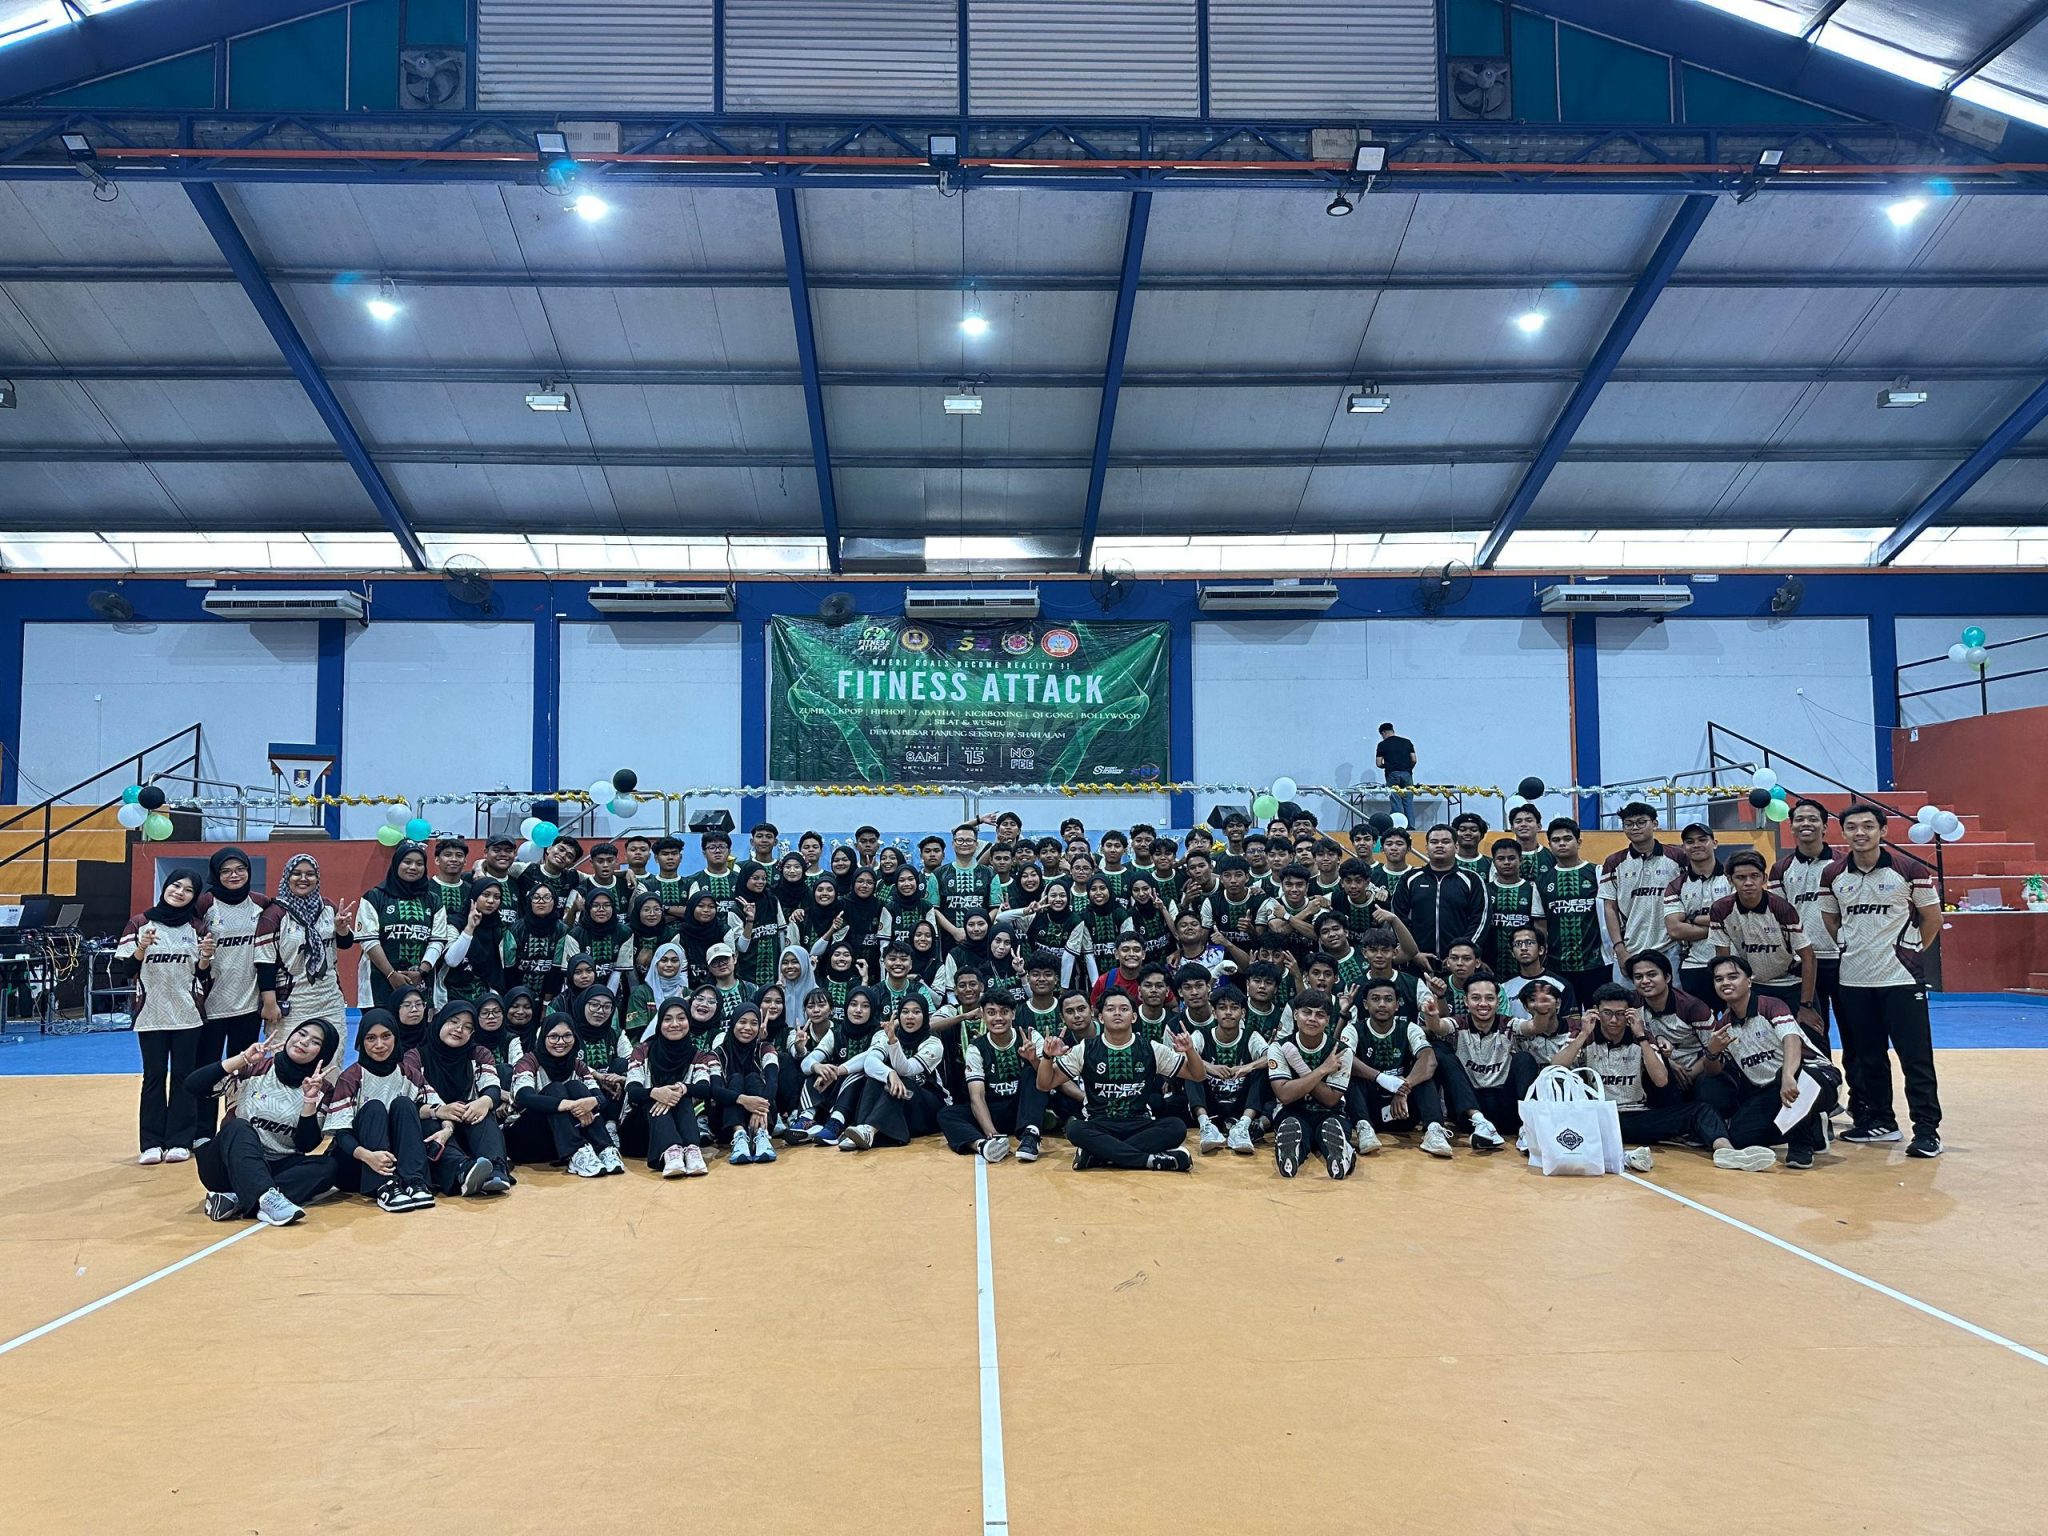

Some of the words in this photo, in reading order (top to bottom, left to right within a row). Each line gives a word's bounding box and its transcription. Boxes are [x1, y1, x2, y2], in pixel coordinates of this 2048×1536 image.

[915, 659, 949, 667] GOALS
[957, 660, 999, 669] BECOME
[1007, 662, 1053, 670] REALITY
[837, 669, 967, 701] FITNESS
[982, 672, 1104, 704] ATTACK
[798, 707, 831, 715] ZUMBA
[870, 708, 906, 716] HIPHOP
[913, 709, 956, 717] TABATHA
[965, 710, 1023, 718] KICKBOXING
[1032, 711, 1044, 719] QI
[1045, 711, 1073, 719] GONG
[1081, 712, 1141, 720] BOLLYWOOD
[934, 718, 960, 726] SILAT
[929, 729, 968, 738] TANJUNG
[1017, 731, 1041, 739] SHAH
[905, 751, 939, 763] 8AM
[964, 750, 985, 765] 15
[1010, 747, 1035, 759] NO
[946, 895, 984, 903] FITNESS
[145, 953, 190, 964] FORFIT
[1741, 1049, 1776, 1069] FORFIT
[1465, 1059, 1504, 1074] FORFIT
